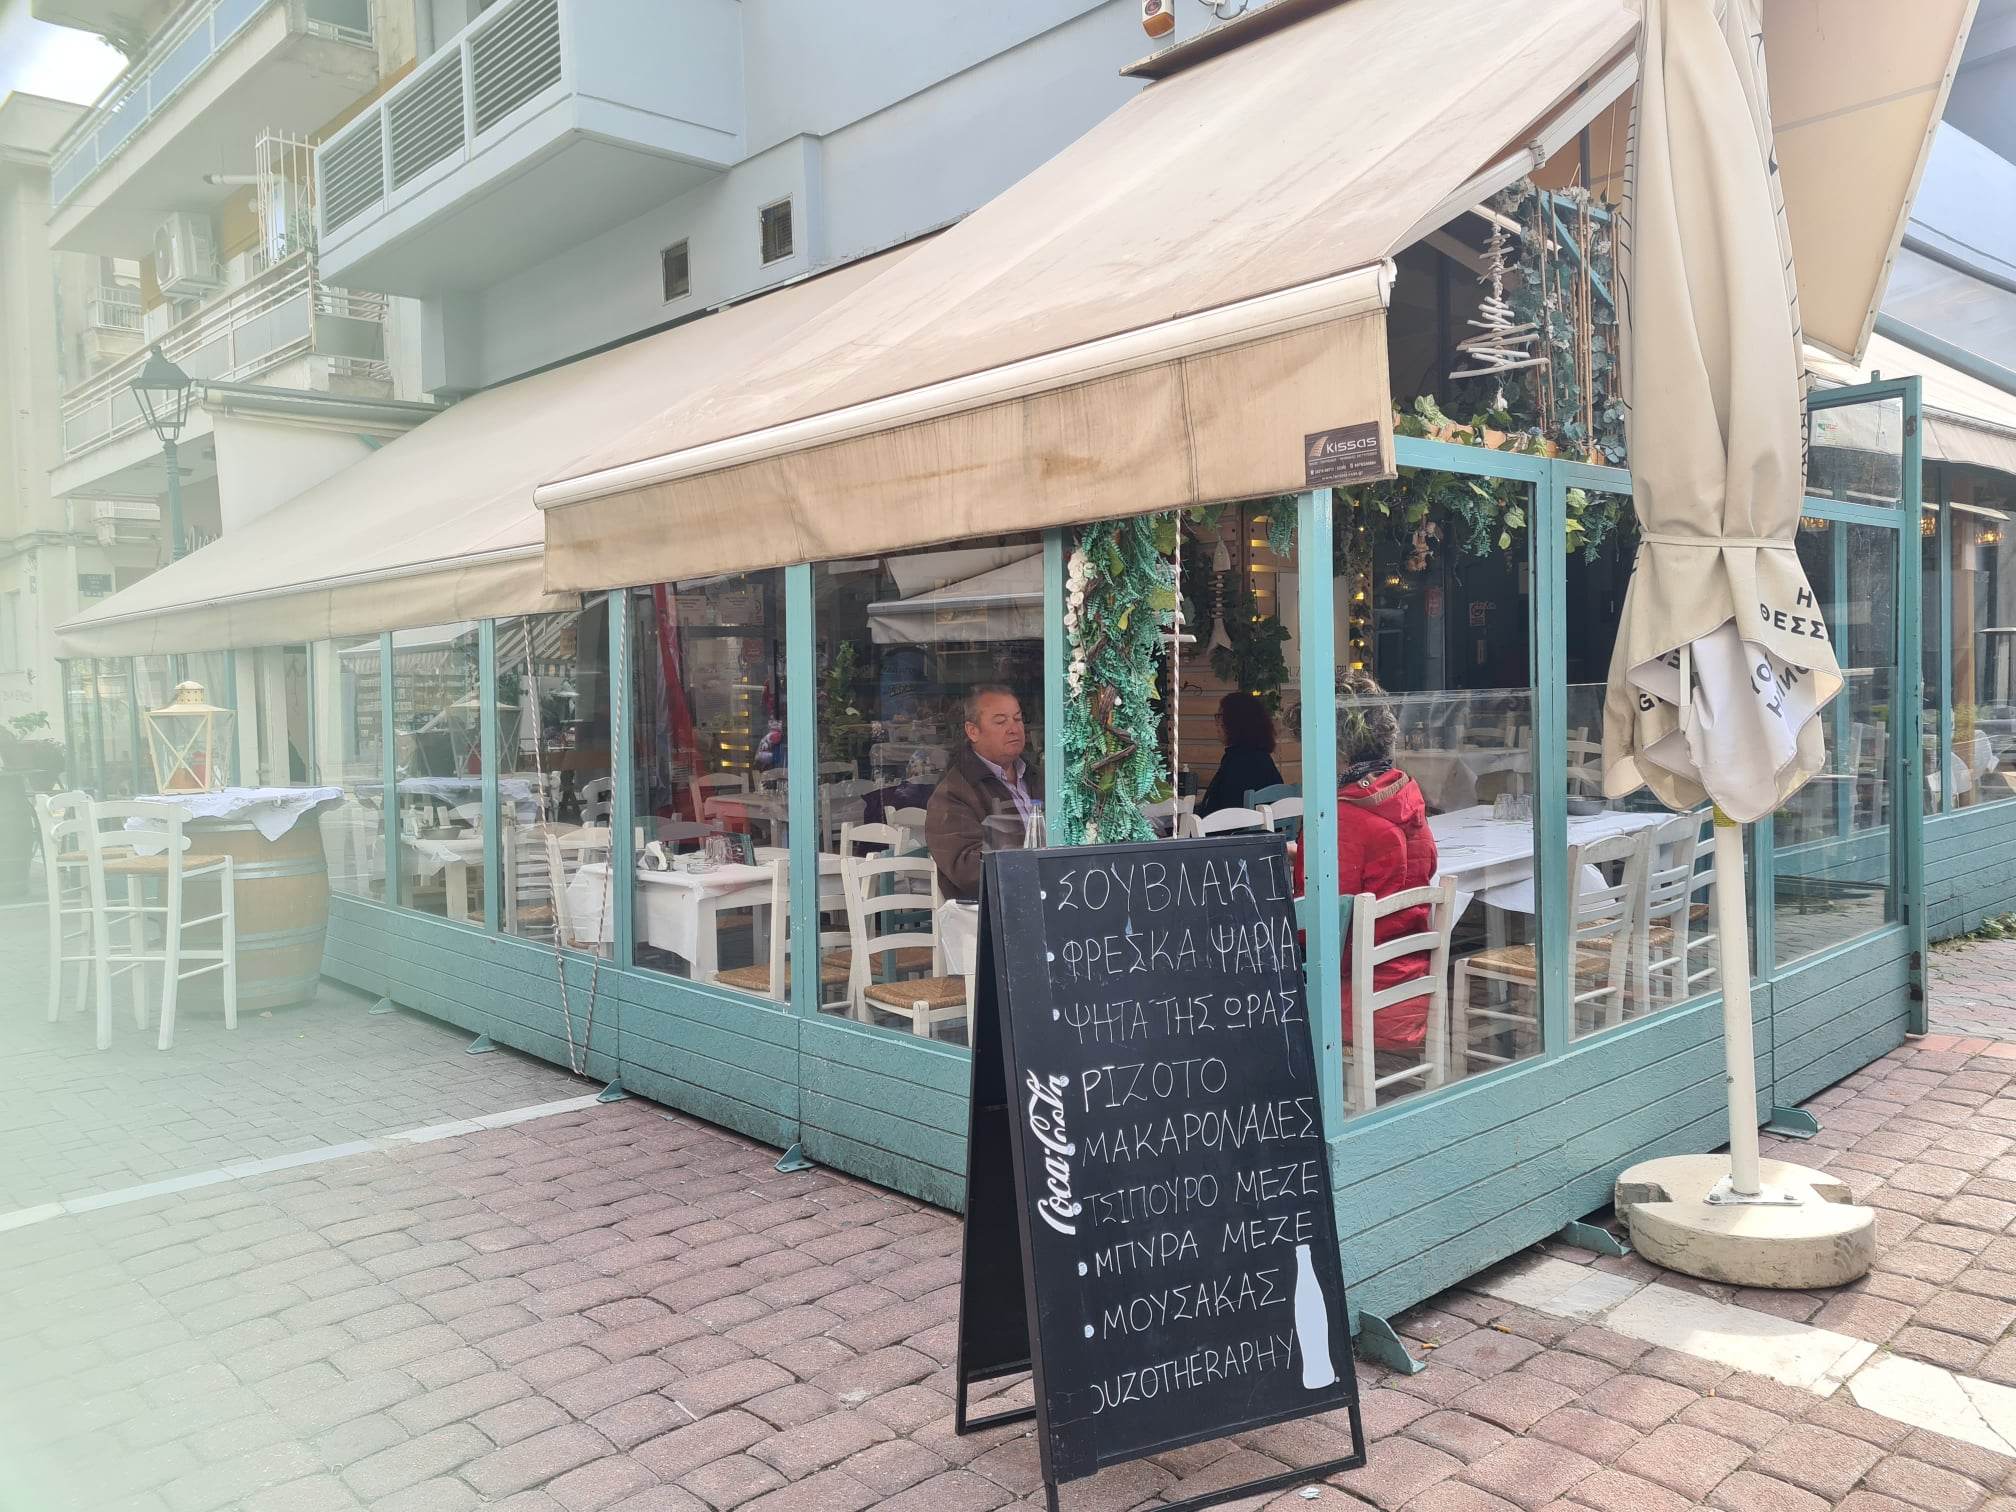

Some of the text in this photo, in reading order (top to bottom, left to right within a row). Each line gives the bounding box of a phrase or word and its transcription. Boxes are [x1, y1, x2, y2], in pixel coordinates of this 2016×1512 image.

[1760, 602, 1828, 641] ΘΕΣΣ
[1058, 854, 1287, 913] ΣΟΥΒΛΑΚΙ
[1062, 915, 1298, 981] ΦΡΕΣΚΑ ΨΑΡΙΑ
[1064, 1000, 1148, 1045] ΨΗΤΑ
[1154, 994, 1215, 1036] ΤΗΣ
[1081, 1056, 1228, 1113] ΡΙΖΟΤΟ
[1082, 1096, 1319, 1168] ΜΑΚΑΡΟΝΑΔΕΣ
[1082, 1159, 1319, 1227] ΤΣΙΠΟΥΡΟ ΜΕΖΕ
[1095, 1210, 1313, 1278] ΜΠΥΡΑ ΜΕΖΕ
[1102, 1267, 1287, 1340] ΜΟΥΣΑΚΑΣ
